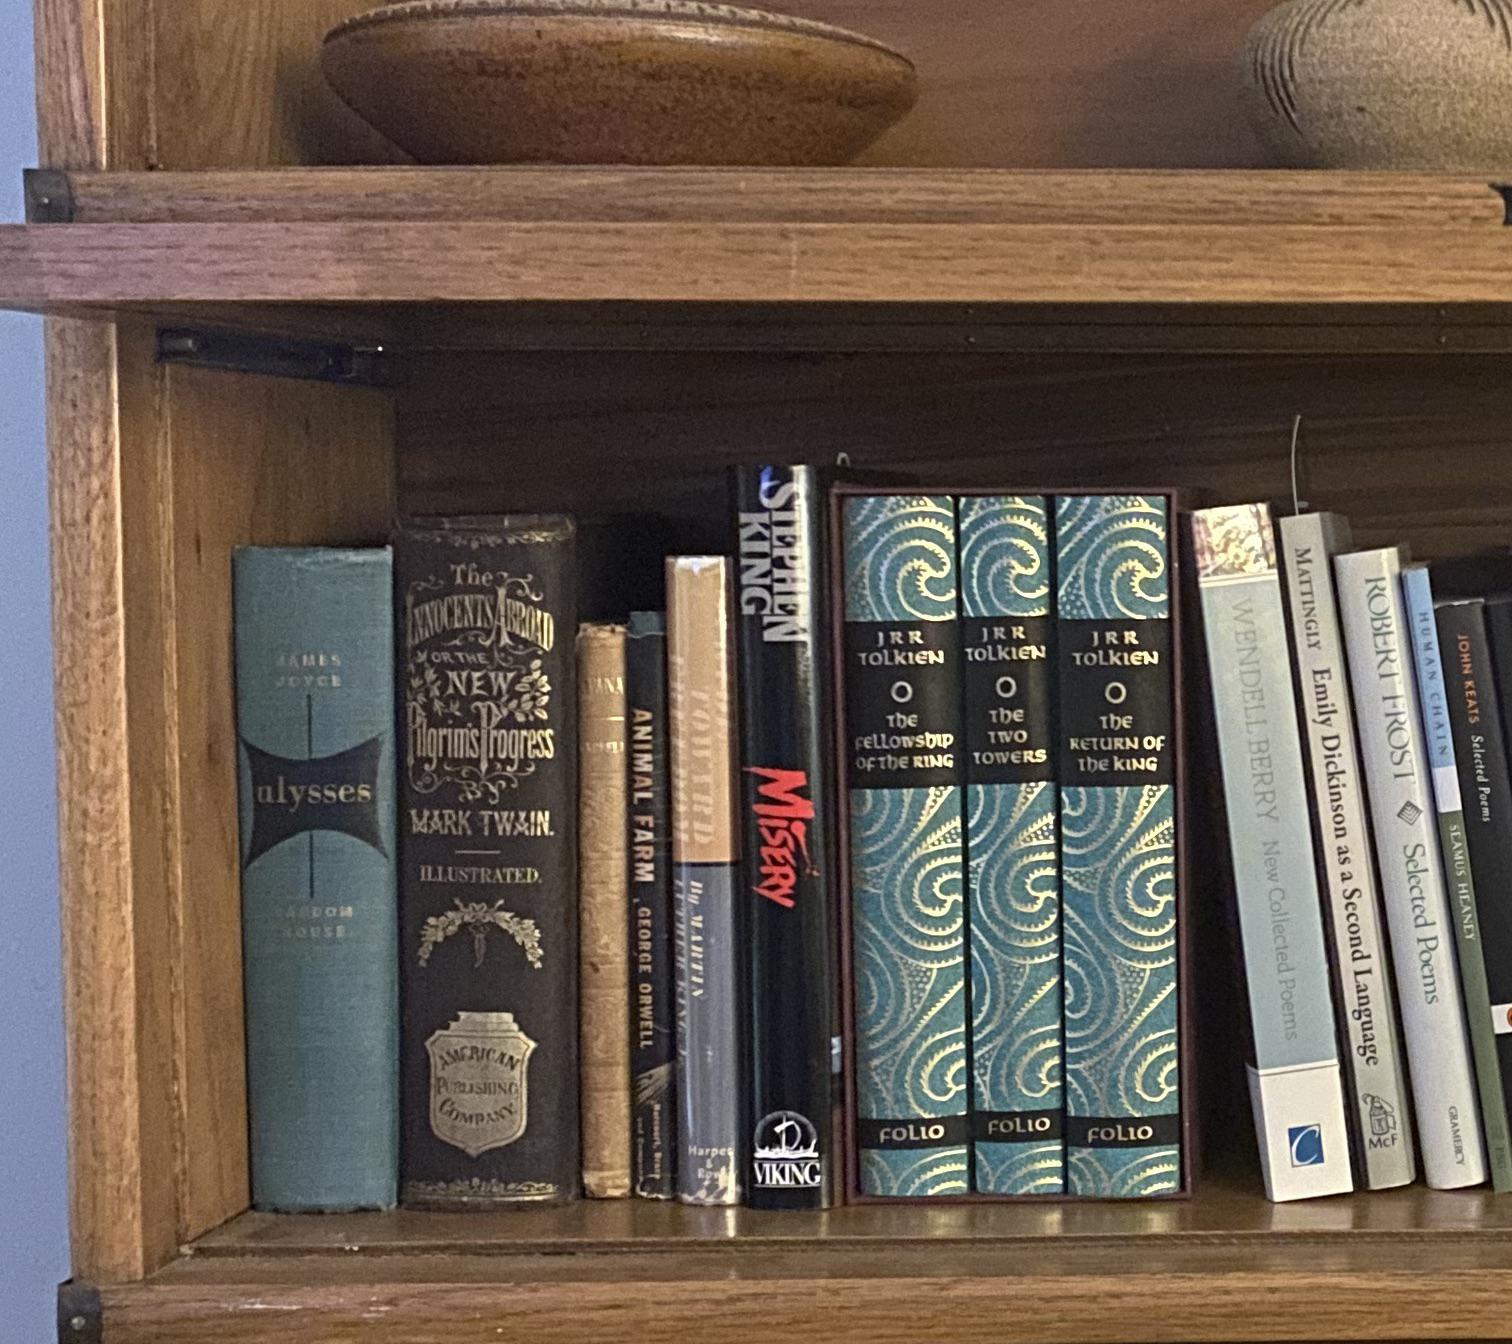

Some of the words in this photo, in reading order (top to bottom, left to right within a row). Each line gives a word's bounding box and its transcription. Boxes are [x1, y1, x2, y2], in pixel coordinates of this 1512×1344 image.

[739, 511, 772, 616] KING
[760, 466, 812, 643] STEPHEN
[1295, 546, 1322, 652] MATTINGLY
[1365, 576, 1400, 680] ROBERT
[445, 671, 517, 698] NEW
[859, 650, 945, 667] TOLKIEN
[1418, 611, 1438, 681] HUMAN
[1429, 692, 1450, 756] CHAIN
[1457, 634, 1473, 677] JOHN
[1231, 598, 1267, 734] WENDELL
[1250, 737, 1279, 823] BERRY
[1312, 668, 1338, 728] Emily
[1463, 679, 1480, 725] KEATS
[632, 709, 654, 805] ANIMAL
[1382, 695, 1416, 781] FROST
[1471, 734, 1490, 784] Selected
[257, 777, 372, 812] ulysses
[1322, 735, 1348, 840] Dickinson
[1478, 784, 1492, 823] Poems
[410, 810, 472, 834] MARK
[633, 814, 655, 883] FARM
[1337, 845, 1351, 865] as
[1449, 823, 1468, 878] SEAMUS
[1263, 841, 1280, 878] New
[1341, 870, 1352, 882] a
[1403, 842, 1436, 930] Selected
[637, 906, 652, 975] GEORGE
[1266, 882, 1294, 974] Collected
[1342, 888, 1363, 962] Second
[1456, 884, 1477, 941] HEANEY
[1417, 935, 1440, 1006] Poems
[638, 982, 654, 1048] ORWELL
[1280, 979, 1298, 1041] Poems
[1352, 967, 1379, 1066] Language
[753, 1162, 821, 1186] VIKING
